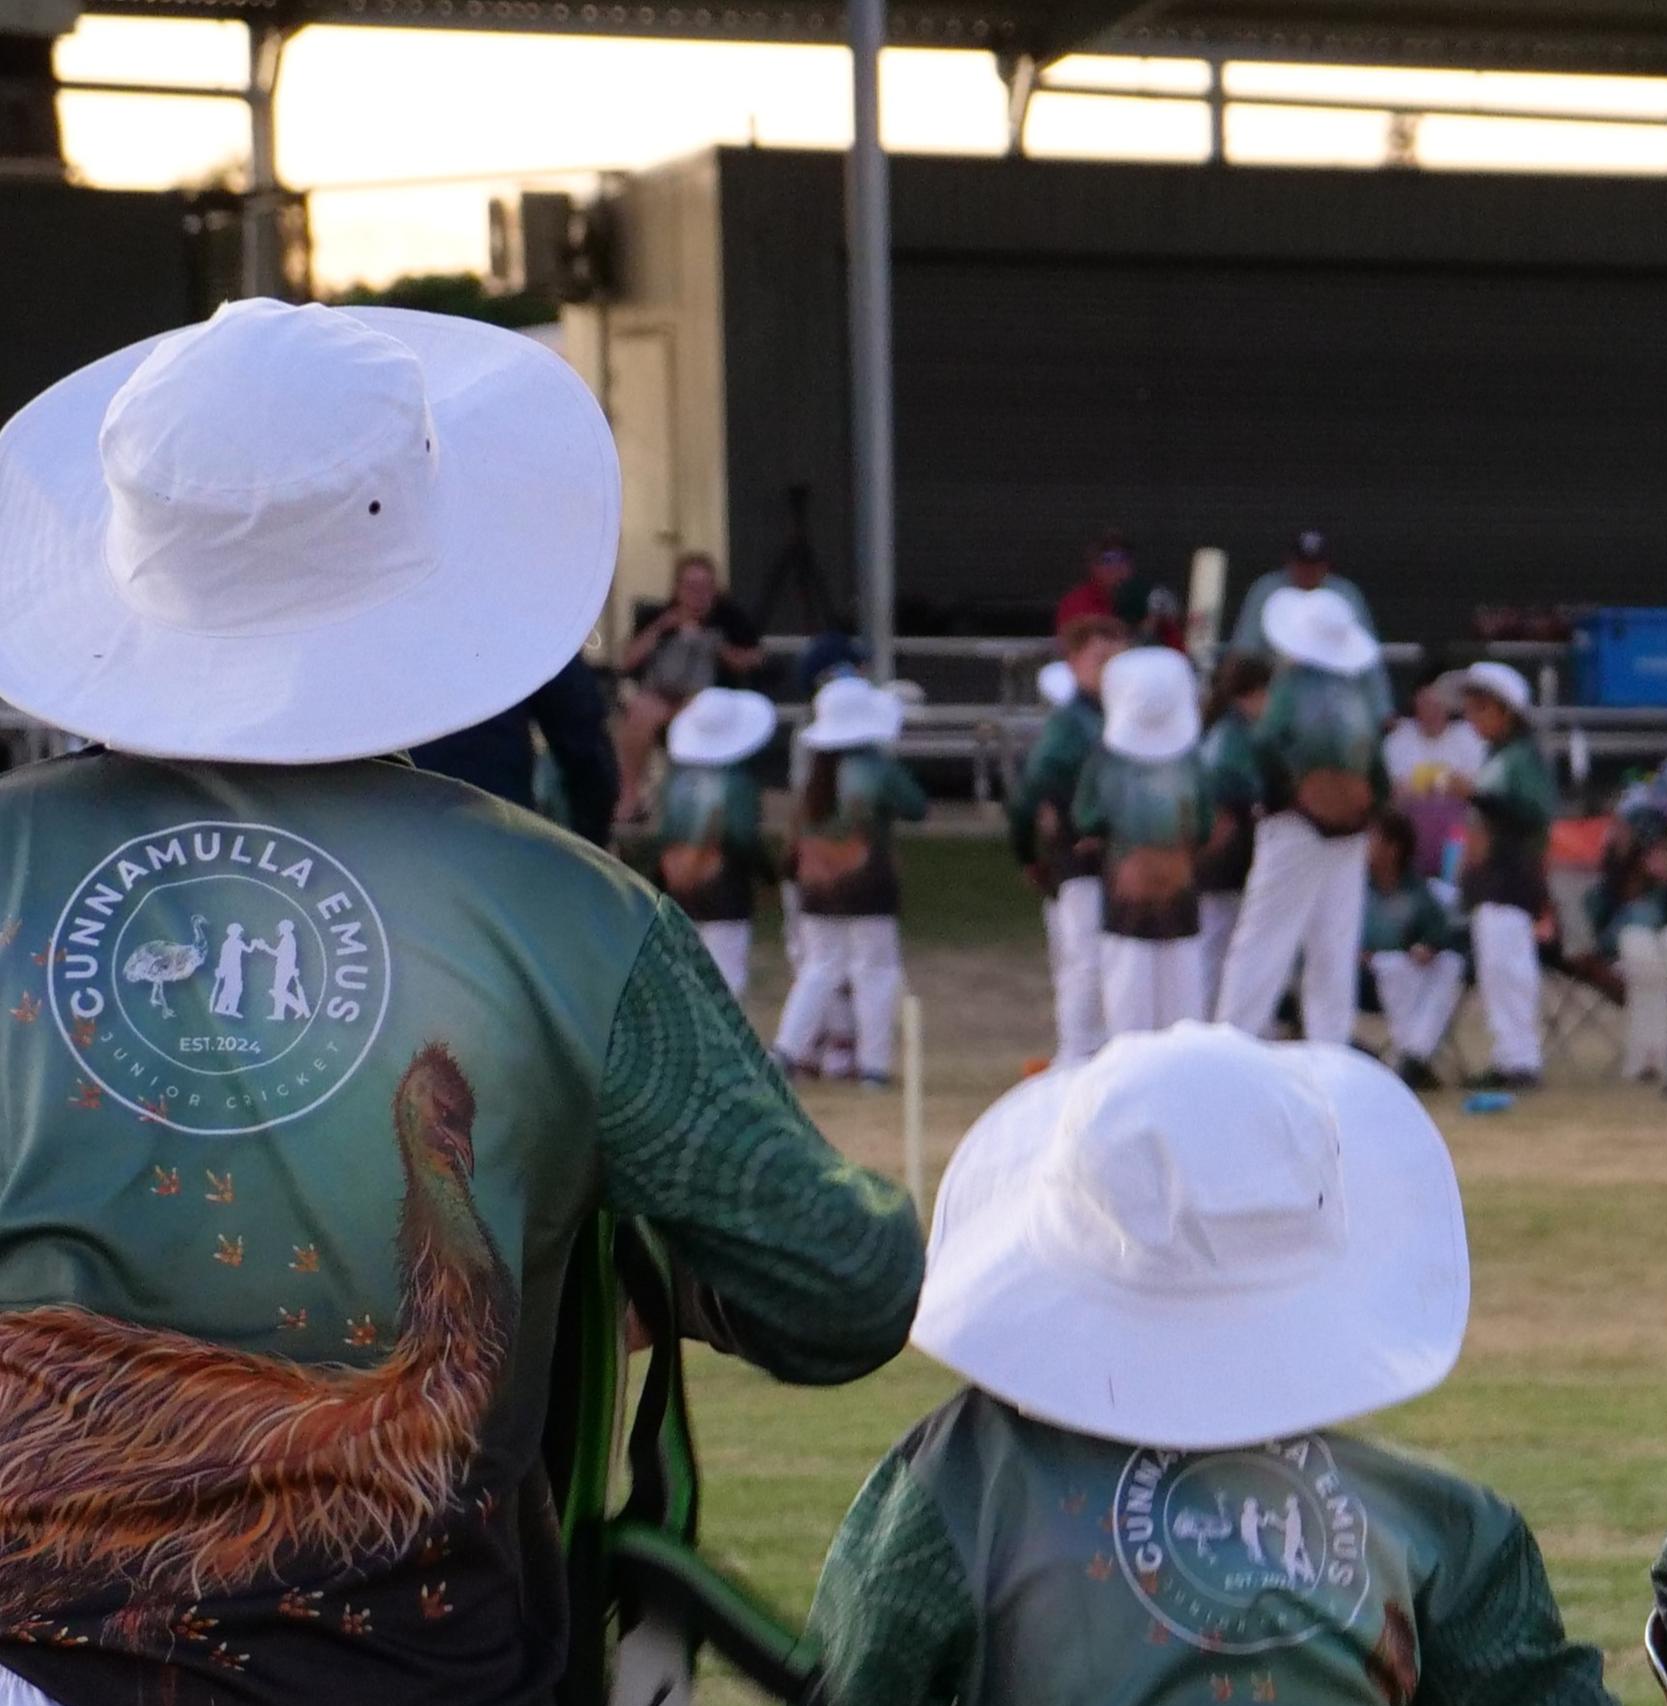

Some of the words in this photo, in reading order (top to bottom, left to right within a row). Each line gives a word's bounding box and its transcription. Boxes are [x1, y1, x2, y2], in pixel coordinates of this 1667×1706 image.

[65, 832, 314, 1019] CUNNAMULLA
[317, 891, 369, 1023] EMUS
[101, 1031, 200, 1107] JUNIOR
